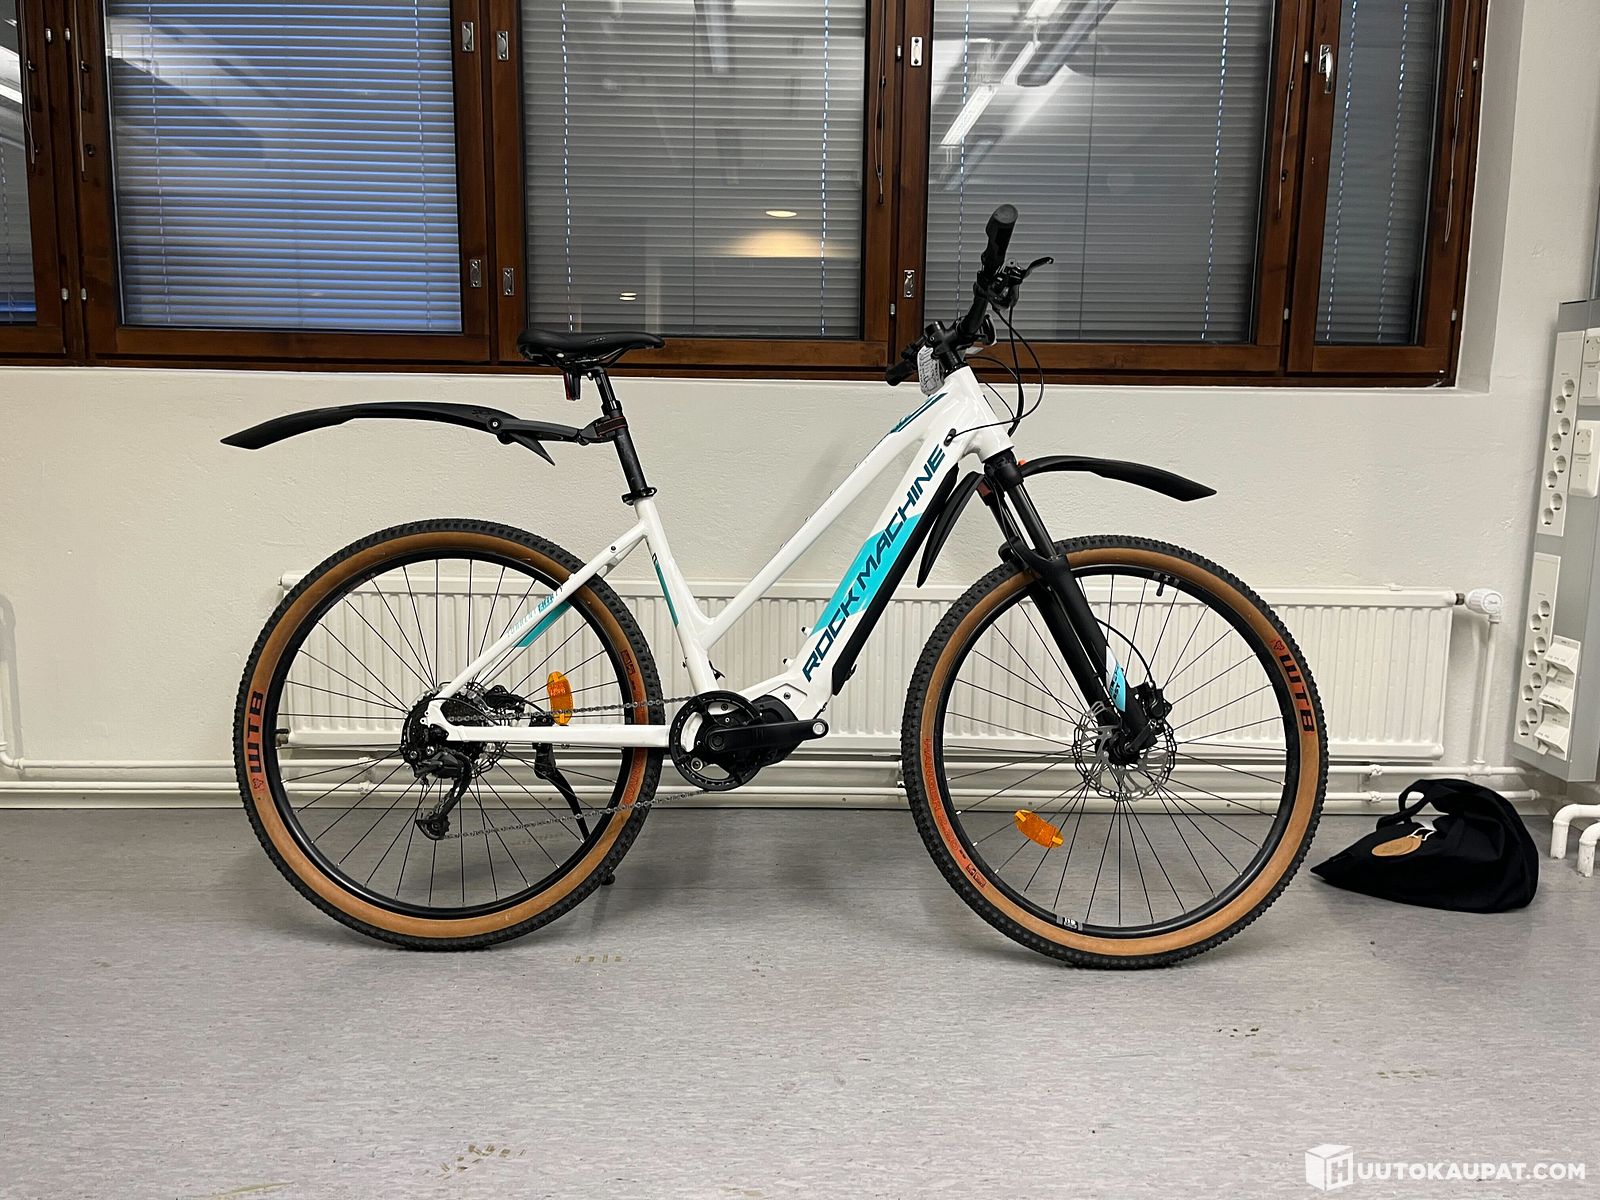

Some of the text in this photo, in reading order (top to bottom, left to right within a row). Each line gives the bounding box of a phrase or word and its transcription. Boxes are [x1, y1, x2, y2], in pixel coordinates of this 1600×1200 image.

[802, 444, 946, 682] ROCK MACHINE
[247, 691, 264, 773] WTB
[1280, 655, 1315, 731] WTB
